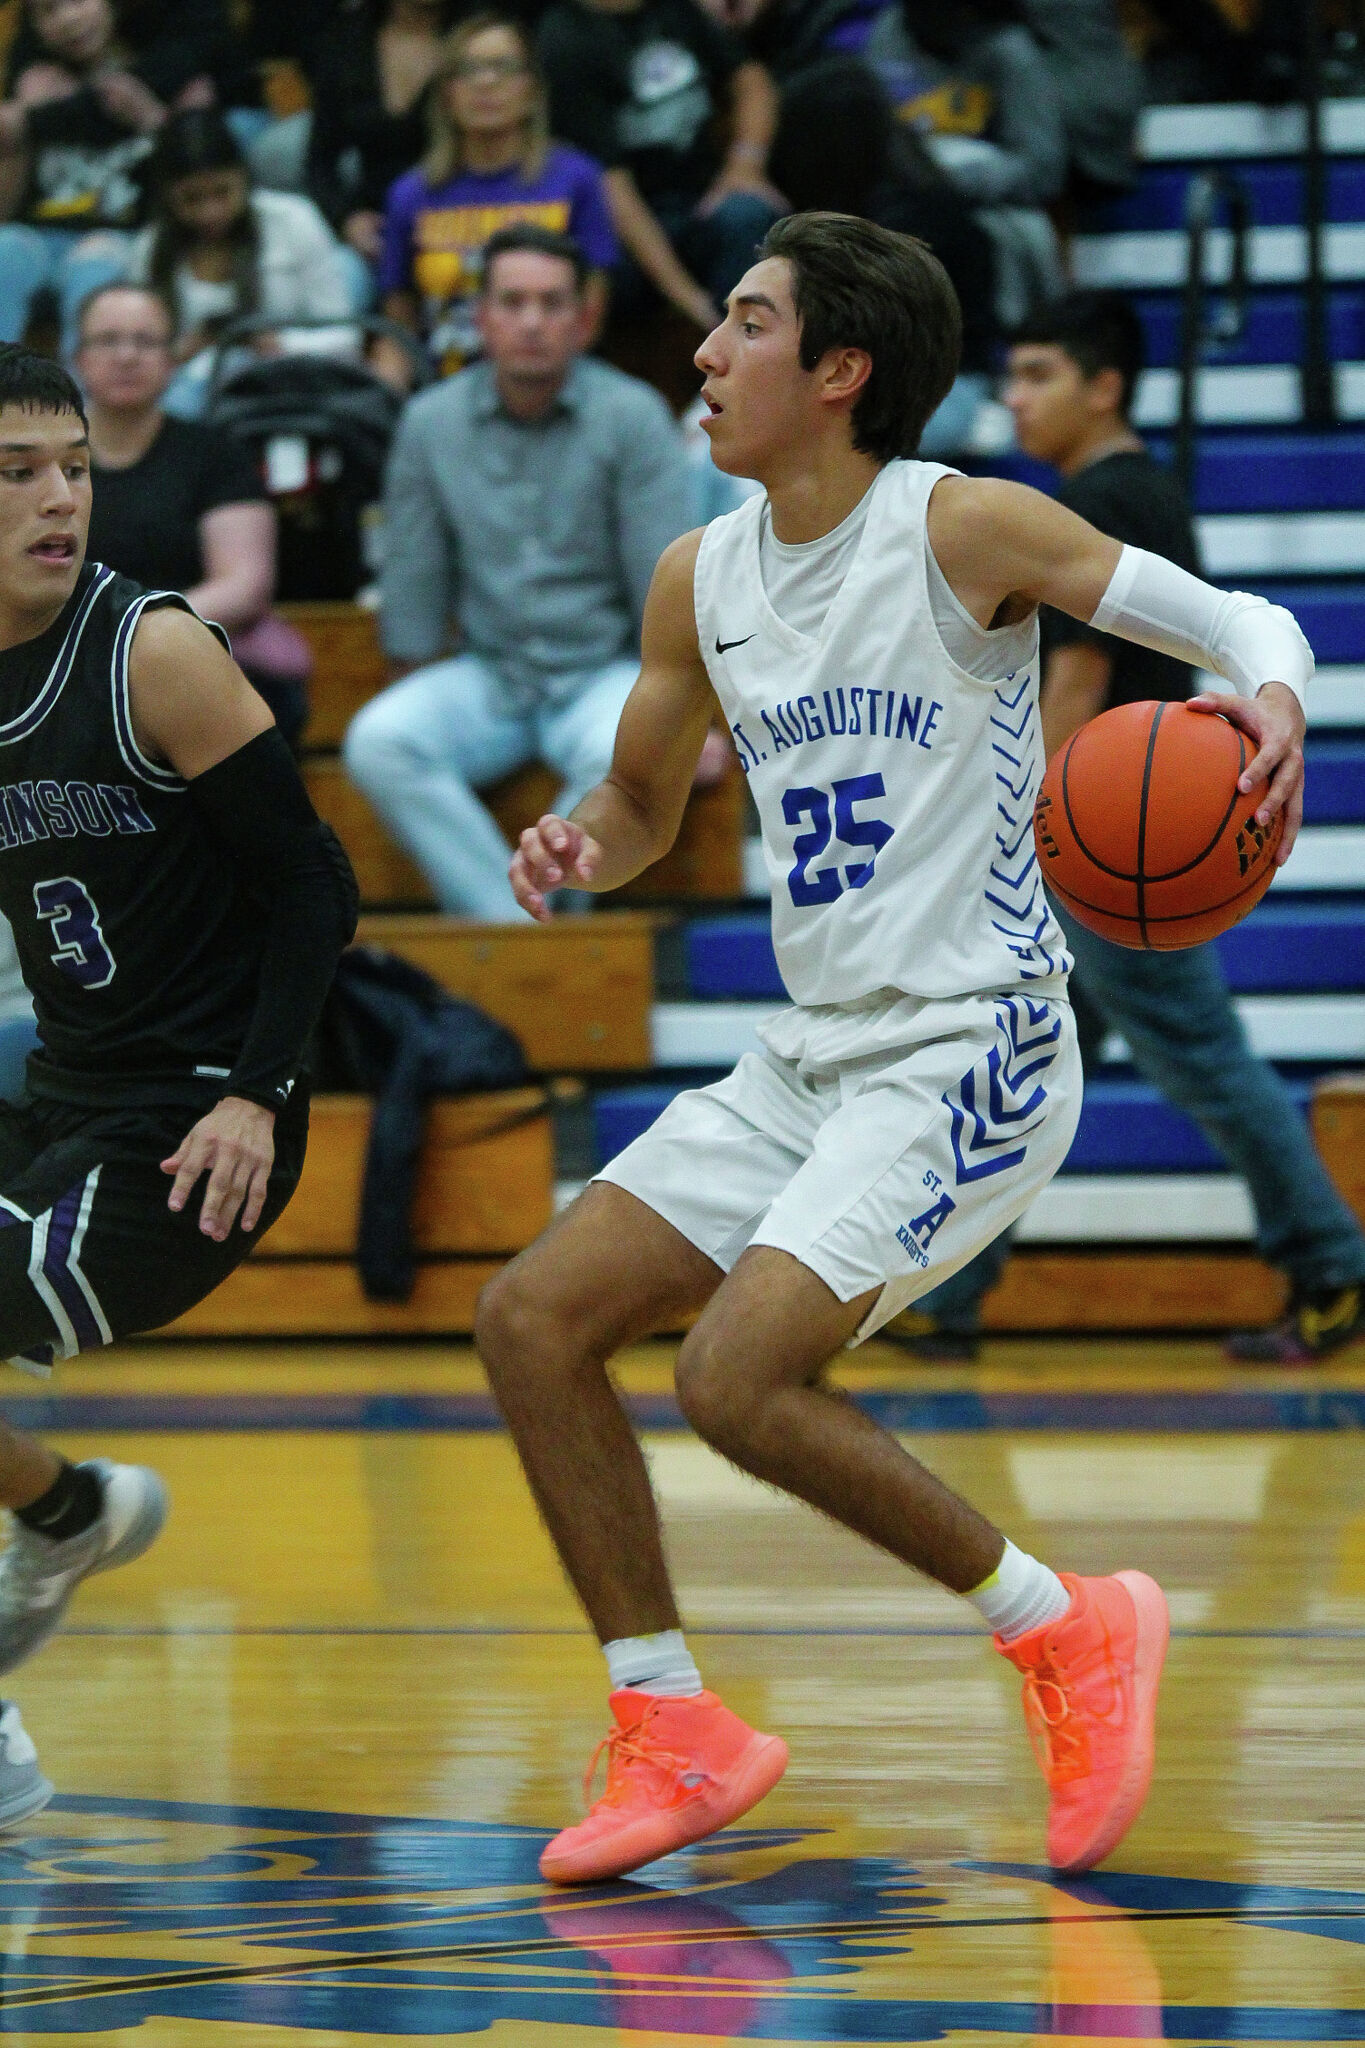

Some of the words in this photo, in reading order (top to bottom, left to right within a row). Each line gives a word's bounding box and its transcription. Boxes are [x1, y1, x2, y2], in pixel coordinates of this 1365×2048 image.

[760, 687, 943, 753] AUGUSTINE
[781, 772, 895, 907] 25
[33, 876, 117, 990] 3
[922, 1169, 942, 1196] ST.
[908, 1192, 957, 1251] A
